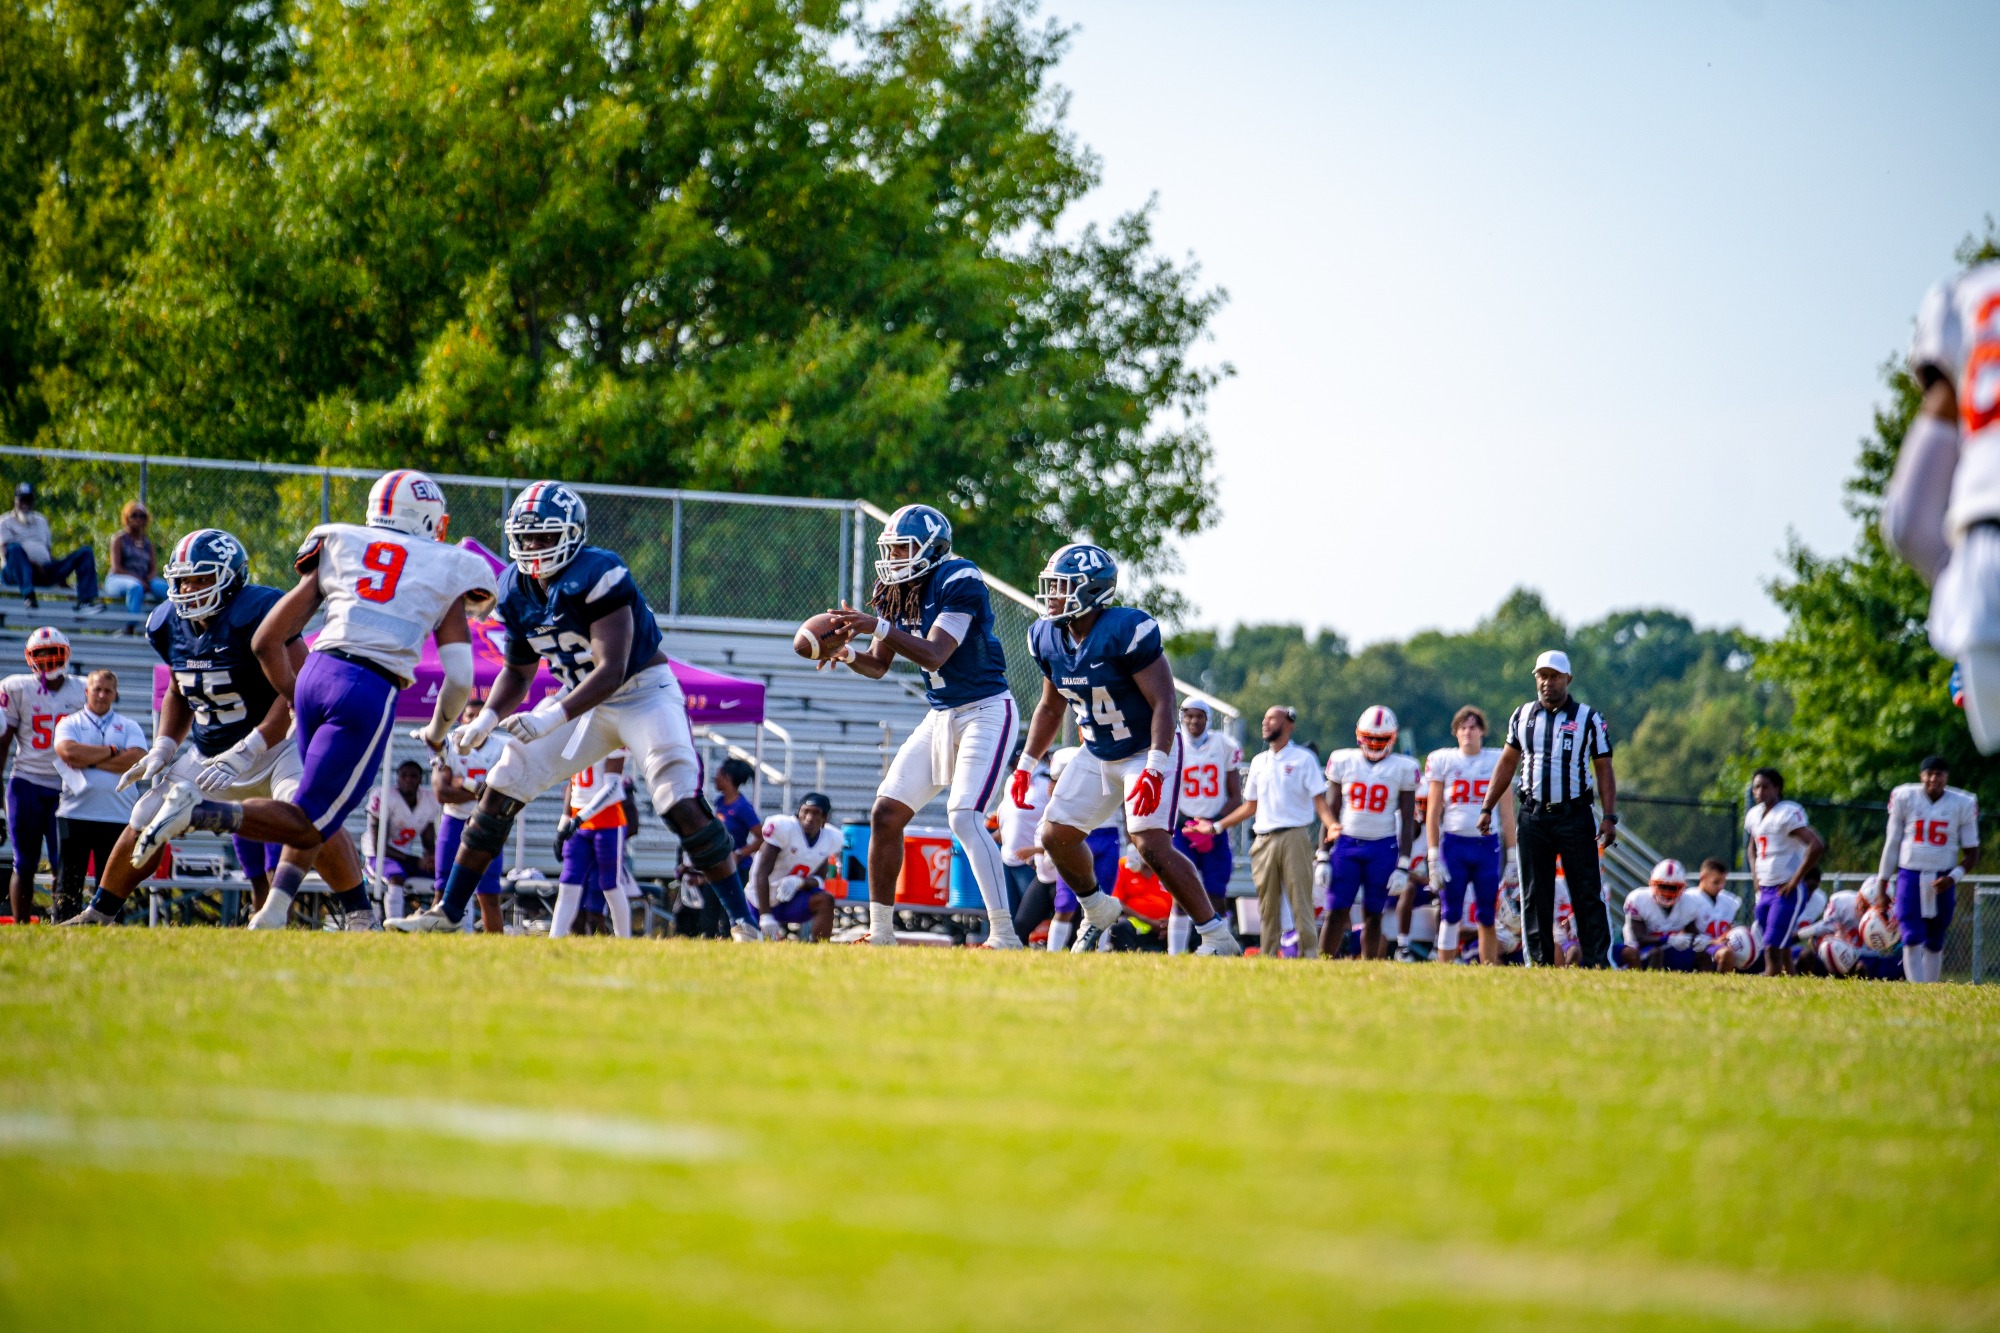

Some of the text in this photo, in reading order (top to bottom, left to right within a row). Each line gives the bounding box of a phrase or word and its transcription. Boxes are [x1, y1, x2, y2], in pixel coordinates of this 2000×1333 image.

[924, 514, 941, 536] 4
[208, 535, 238, 560] 55
[355, 541, 408, 605] 9
[1074, 551, 1102, 572] 24
[1062, 677, 1088, 685] DRAGONS
[175, 671, 247, 725] 55
[1058, 686, 1132, 742] 24
[32, 714, 71, 750] 5
[1563, 738, 1572, 751] R
[1183, 763, 1219, 798] 53
[1350, 781, 1388, 813] 88
[1914, 819, 1948, 846] 16
[933, 849, 950, 871] G
